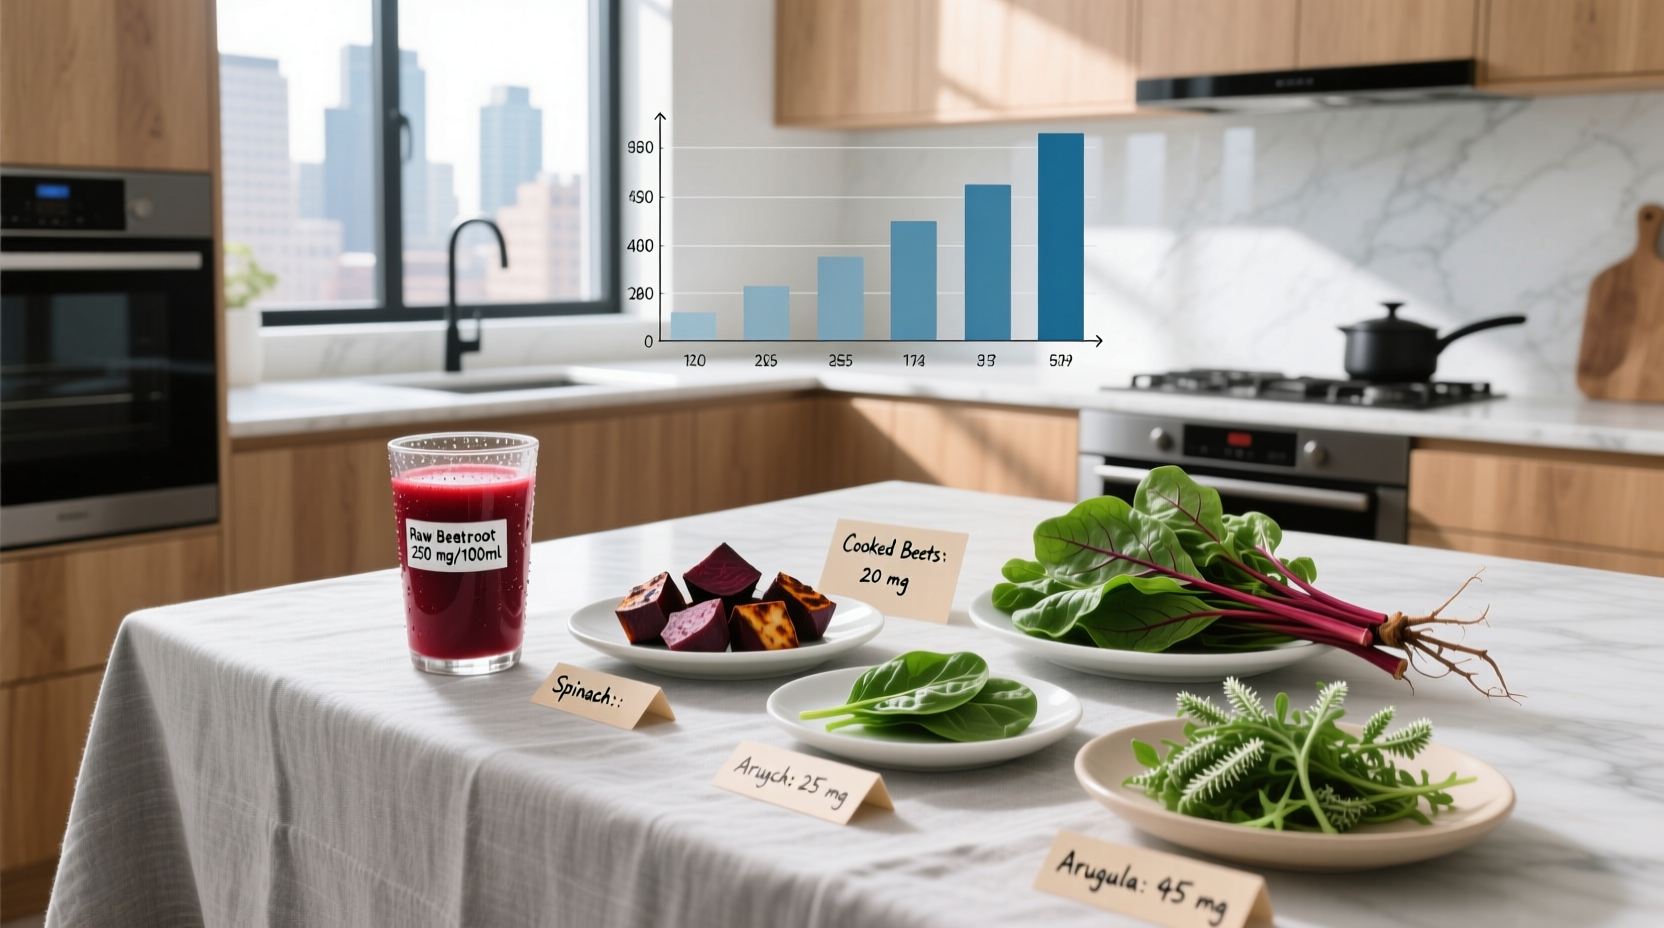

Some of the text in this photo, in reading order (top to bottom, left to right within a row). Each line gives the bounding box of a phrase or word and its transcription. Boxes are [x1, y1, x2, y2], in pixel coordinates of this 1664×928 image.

[410, 527, 496, 544] Raw Beetroot
[842, 532, 947, 563] Cooked Beets:
[411, 544, 502, 566] 250 mg/100ml
[859, 567, 910, 597] 20 mg
[797, 774, 828, 794] 25
[824, 787, 849, 811] mg
[1056, 849, 1228, 927] Arugula: 45 mg
